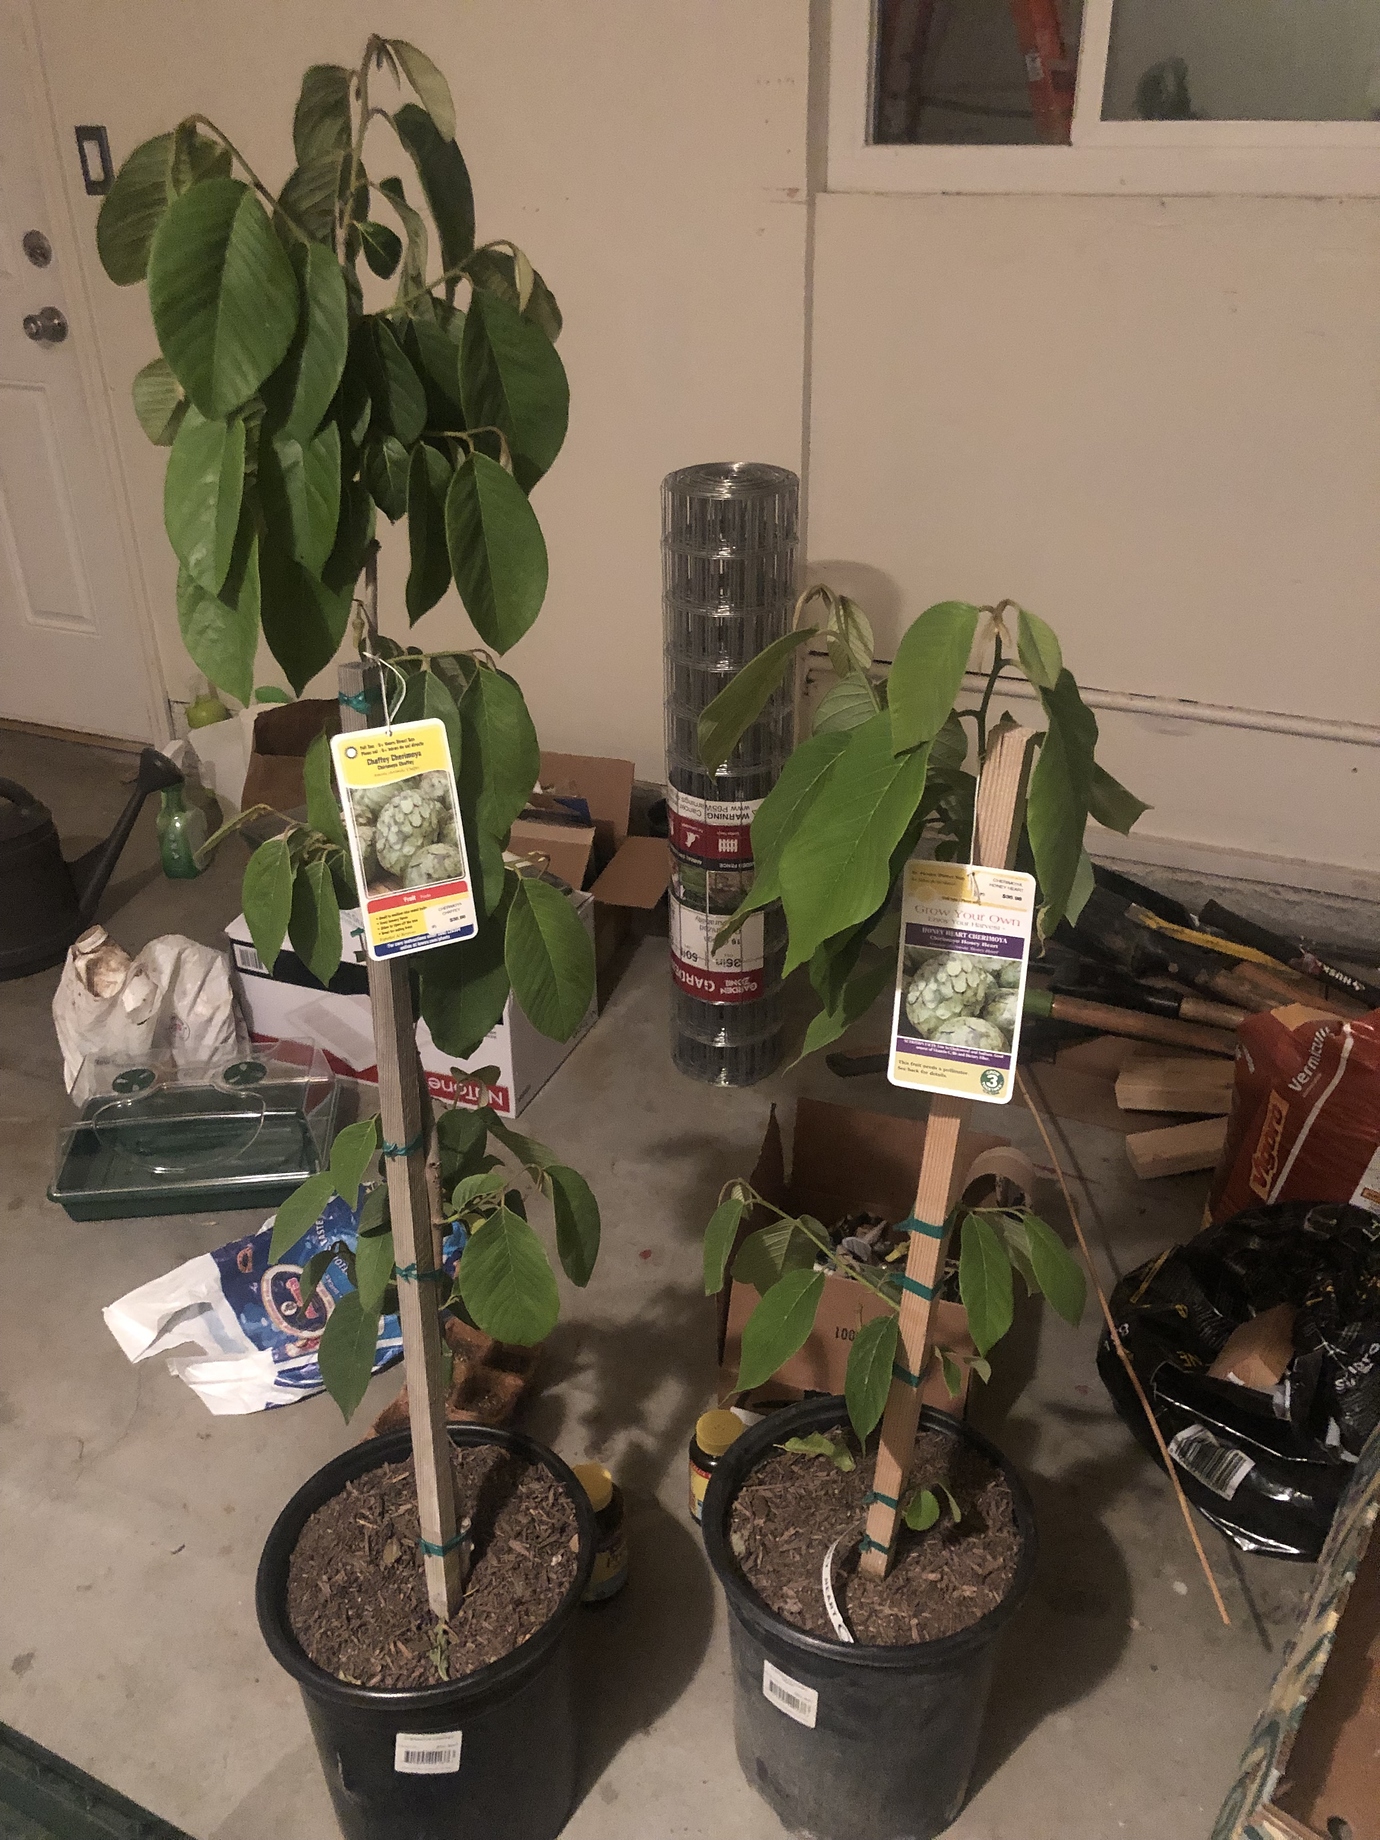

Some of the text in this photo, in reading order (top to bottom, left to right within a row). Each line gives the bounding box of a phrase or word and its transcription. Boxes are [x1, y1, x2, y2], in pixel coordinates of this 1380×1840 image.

[366, 751, 422, 766] Chaffey Cherimoya
[968, 932, 1008, 944] CHERIMOYA
[720, 982, 758, 994] GARDEN
[986, 1074, 998, 1088] 3
